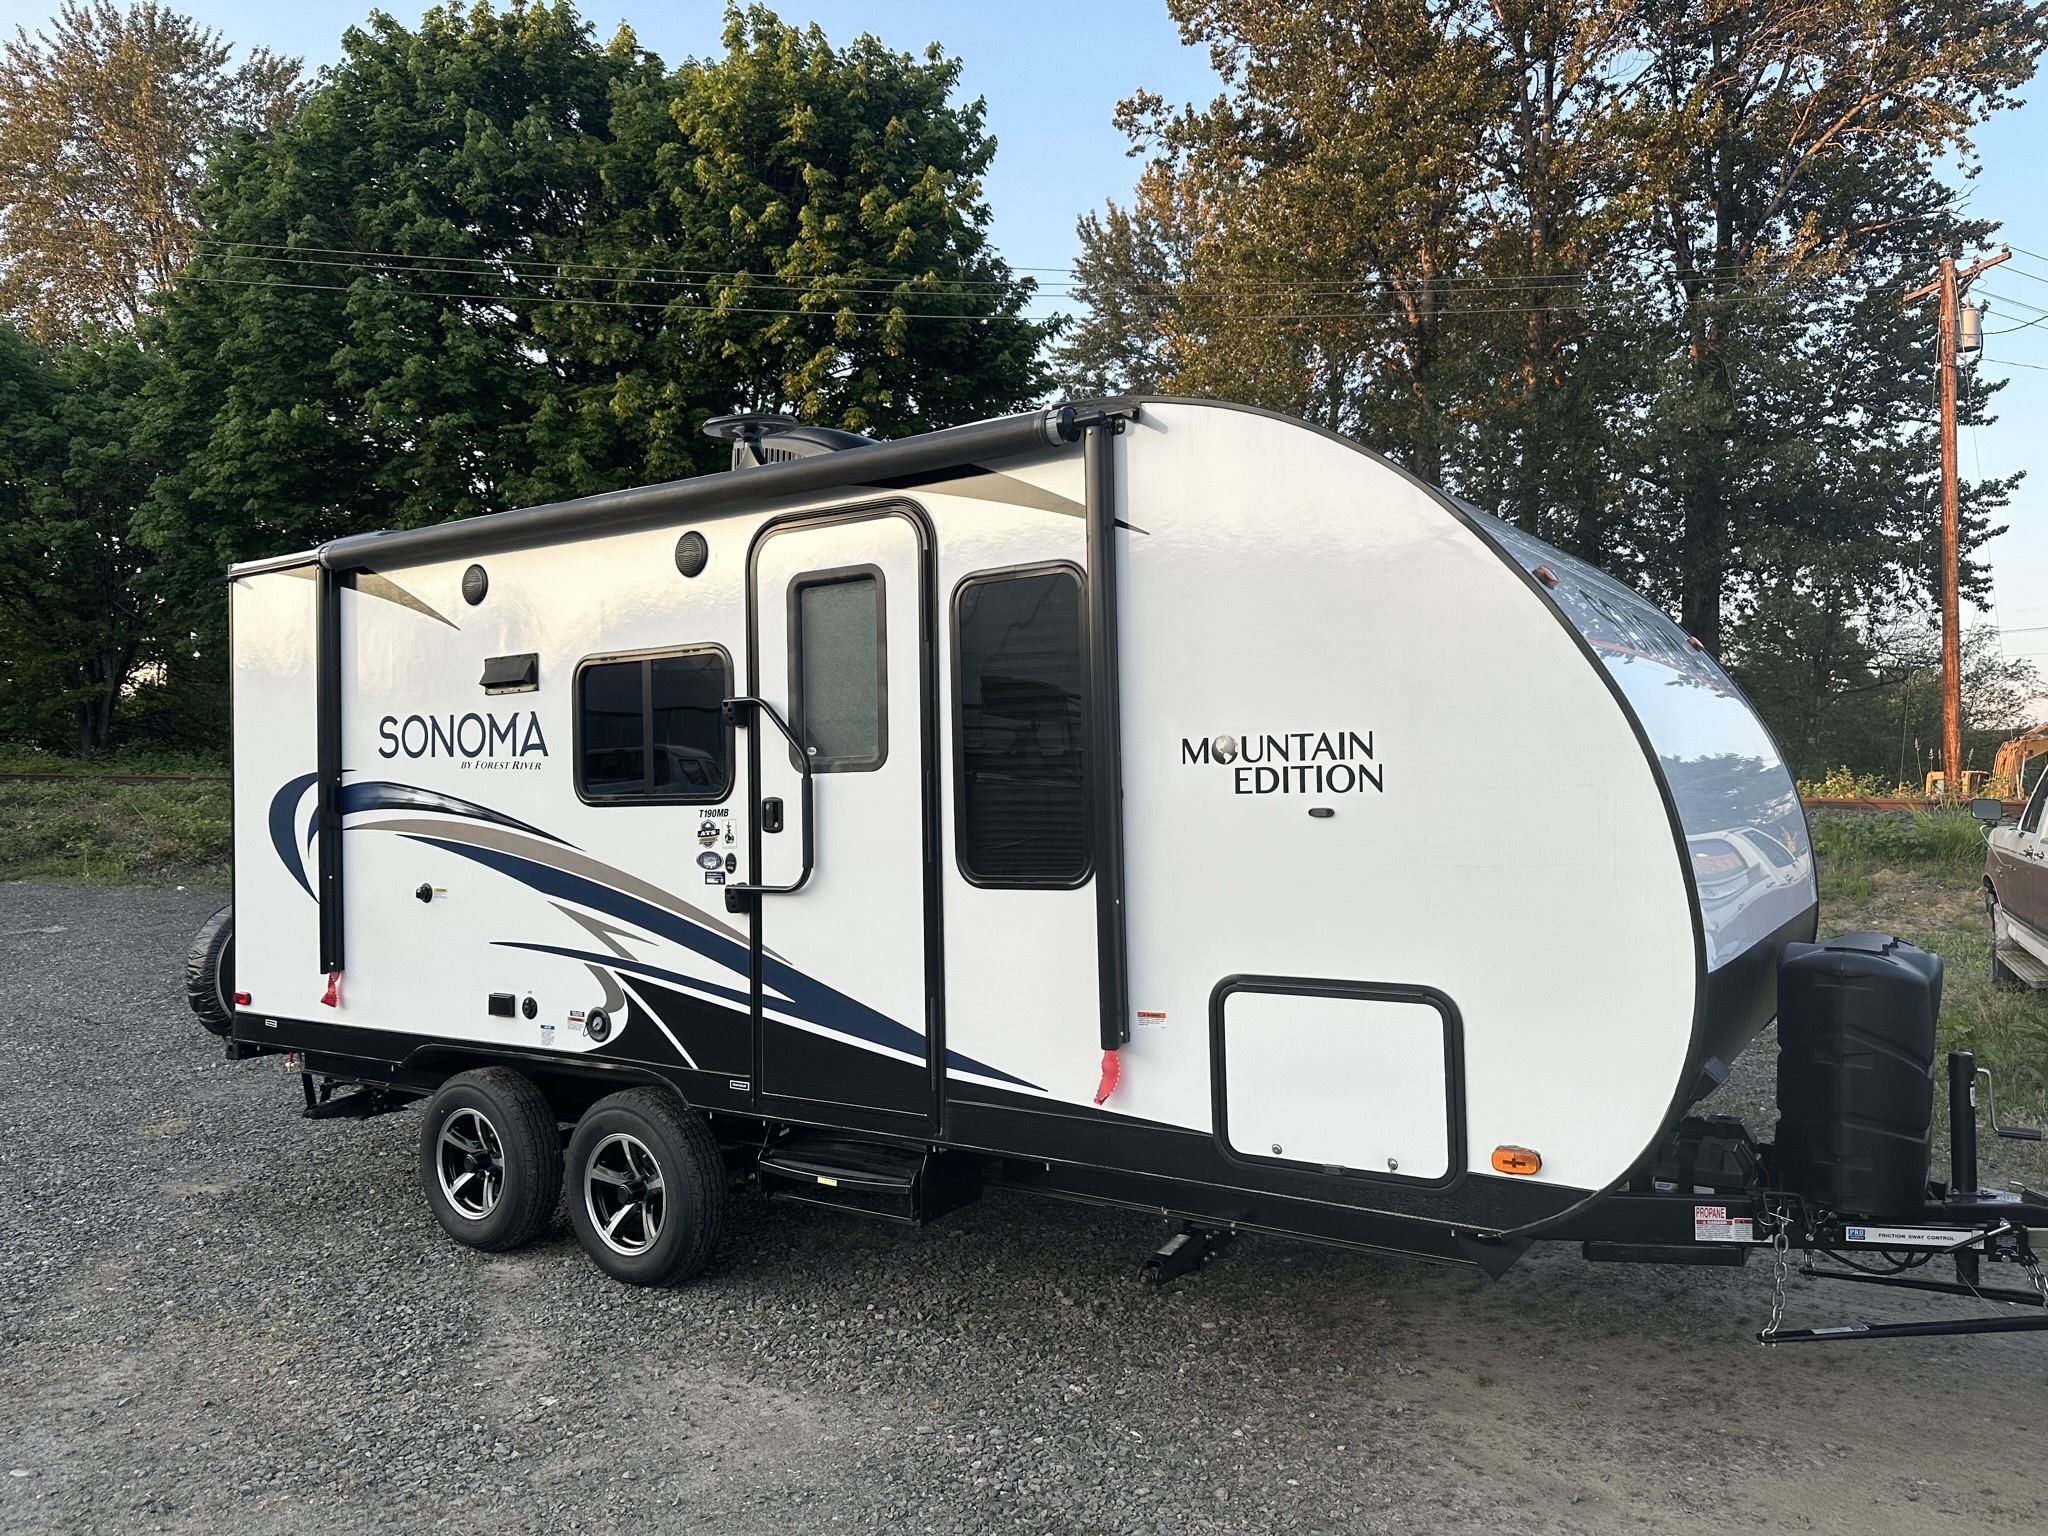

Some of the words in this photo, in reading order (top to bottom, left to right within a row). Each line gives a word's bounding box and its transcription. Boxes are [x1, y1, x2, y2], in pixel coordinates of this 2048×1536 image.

[378, 711, 549, 759] SONOMA
[1182, 730, 1374, 765] MOUNTAIN
[460, 761, 473, 770] BY
[474, 760, 511, 770] FOREST
[511, 760, 542, 771] RIVER
[1234, 763, 1384, 795] EDITION
[699, 809, 729, 818] T190MB
[1696, 1207, 1725, 1218] PROPANE
